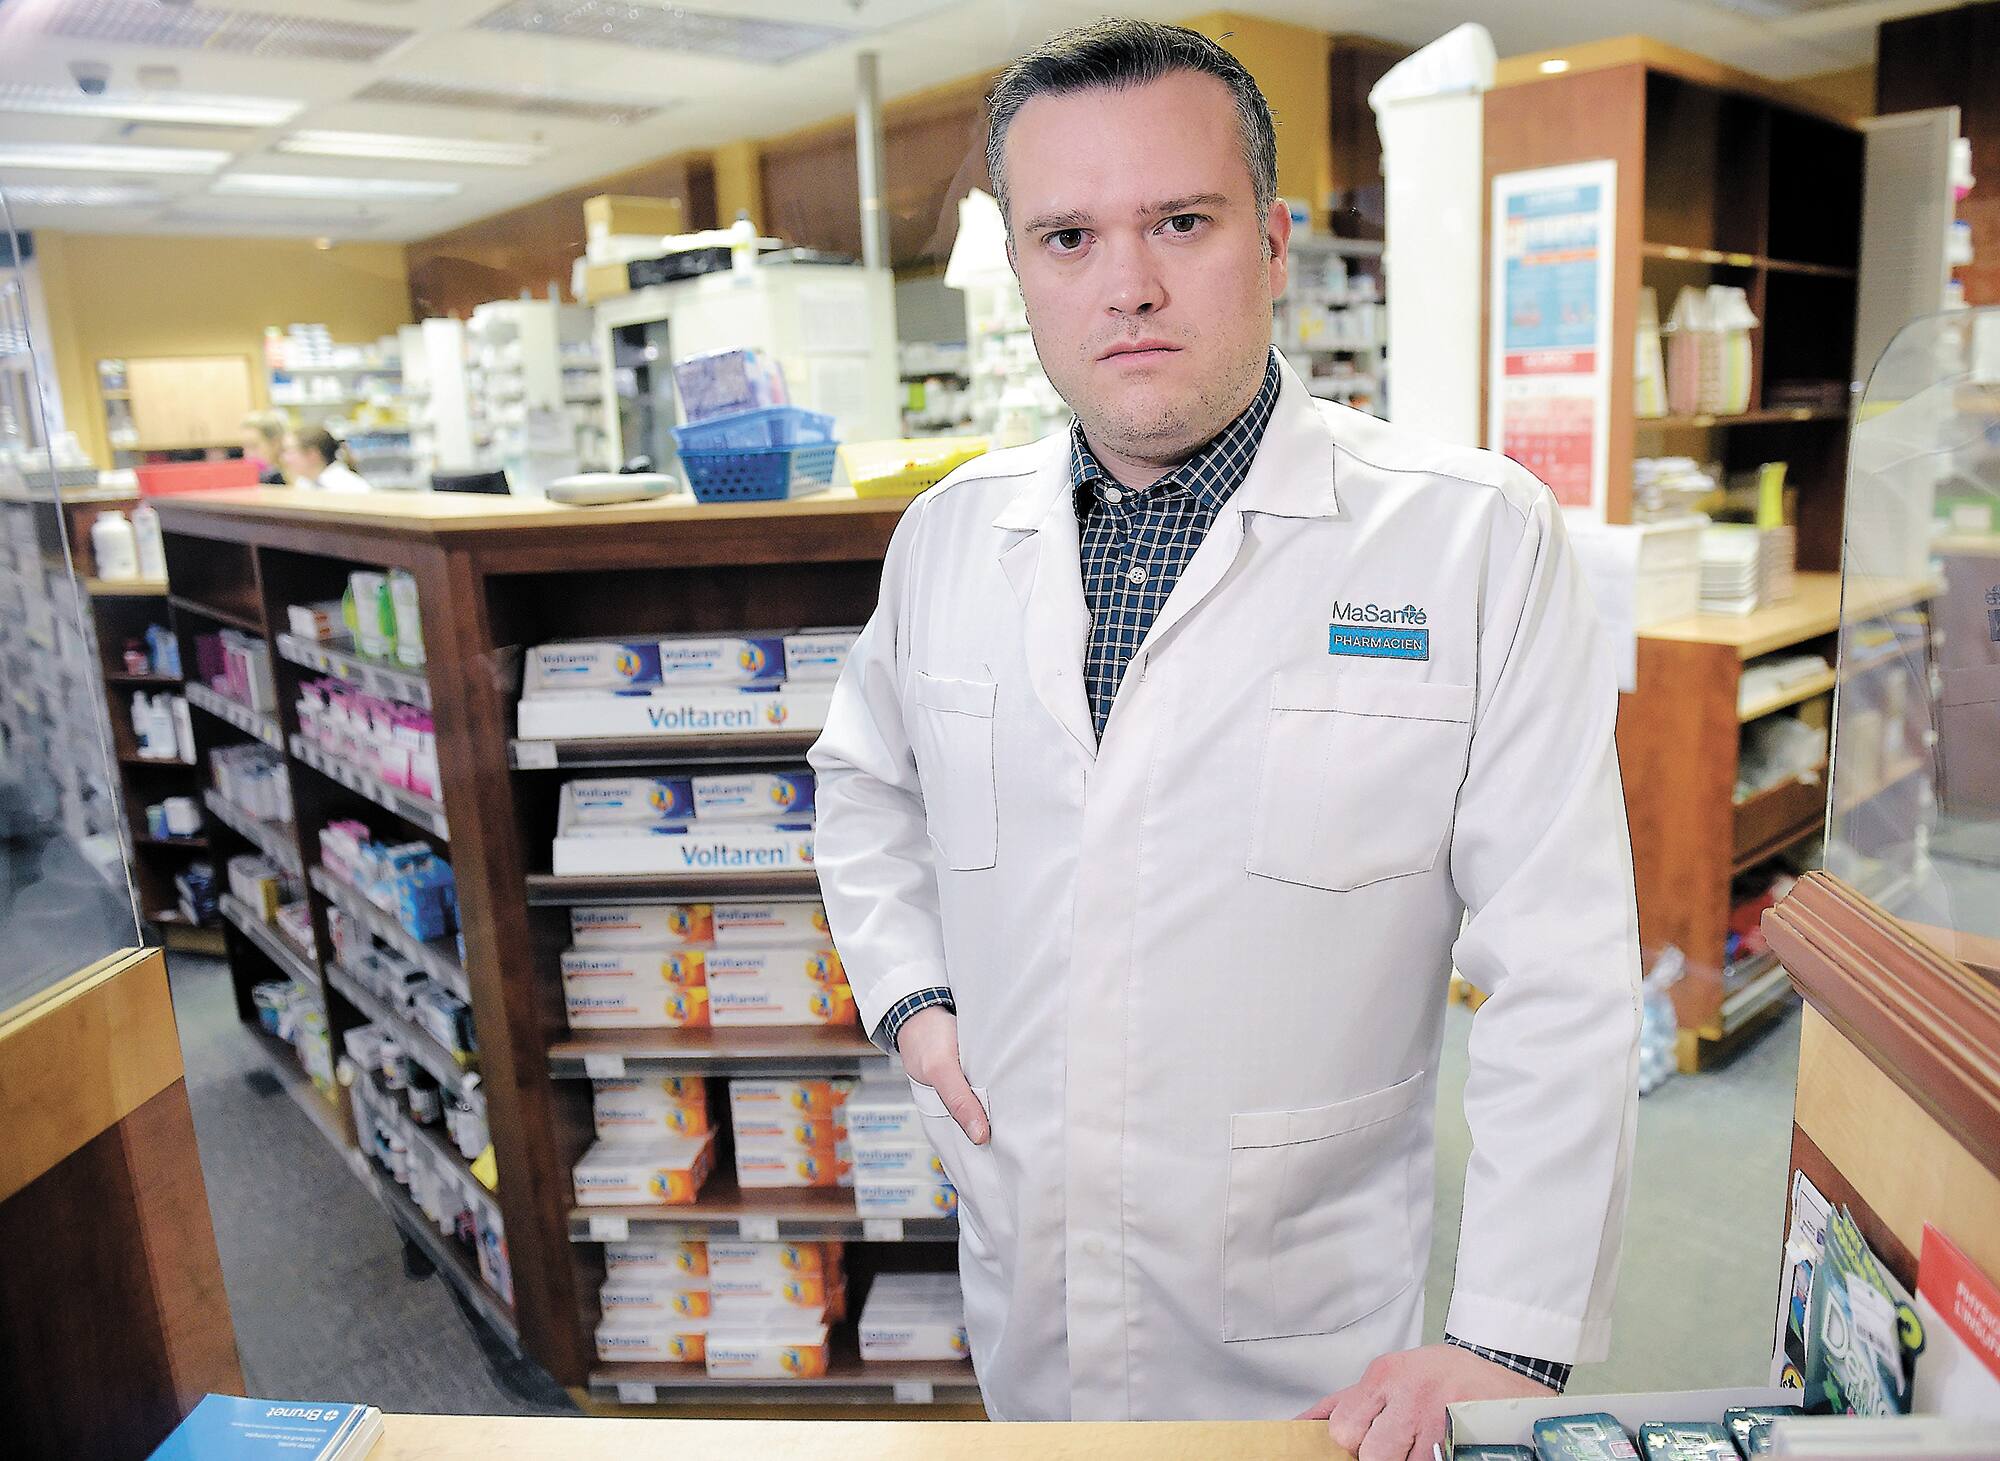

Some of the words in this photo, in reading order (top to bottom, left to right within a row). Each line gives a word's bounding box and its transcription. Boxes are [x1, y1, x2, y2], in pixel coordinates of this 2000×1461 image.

[1332, 601, 1427, 625] MaSanté
[1335, 634, 1422, 650] PHARMACIEN
[648, 702, 750, 729] Voltaren
[681, 844, 784, 866] Voltaren
[265, 1407, 323, 1421] Brunet
